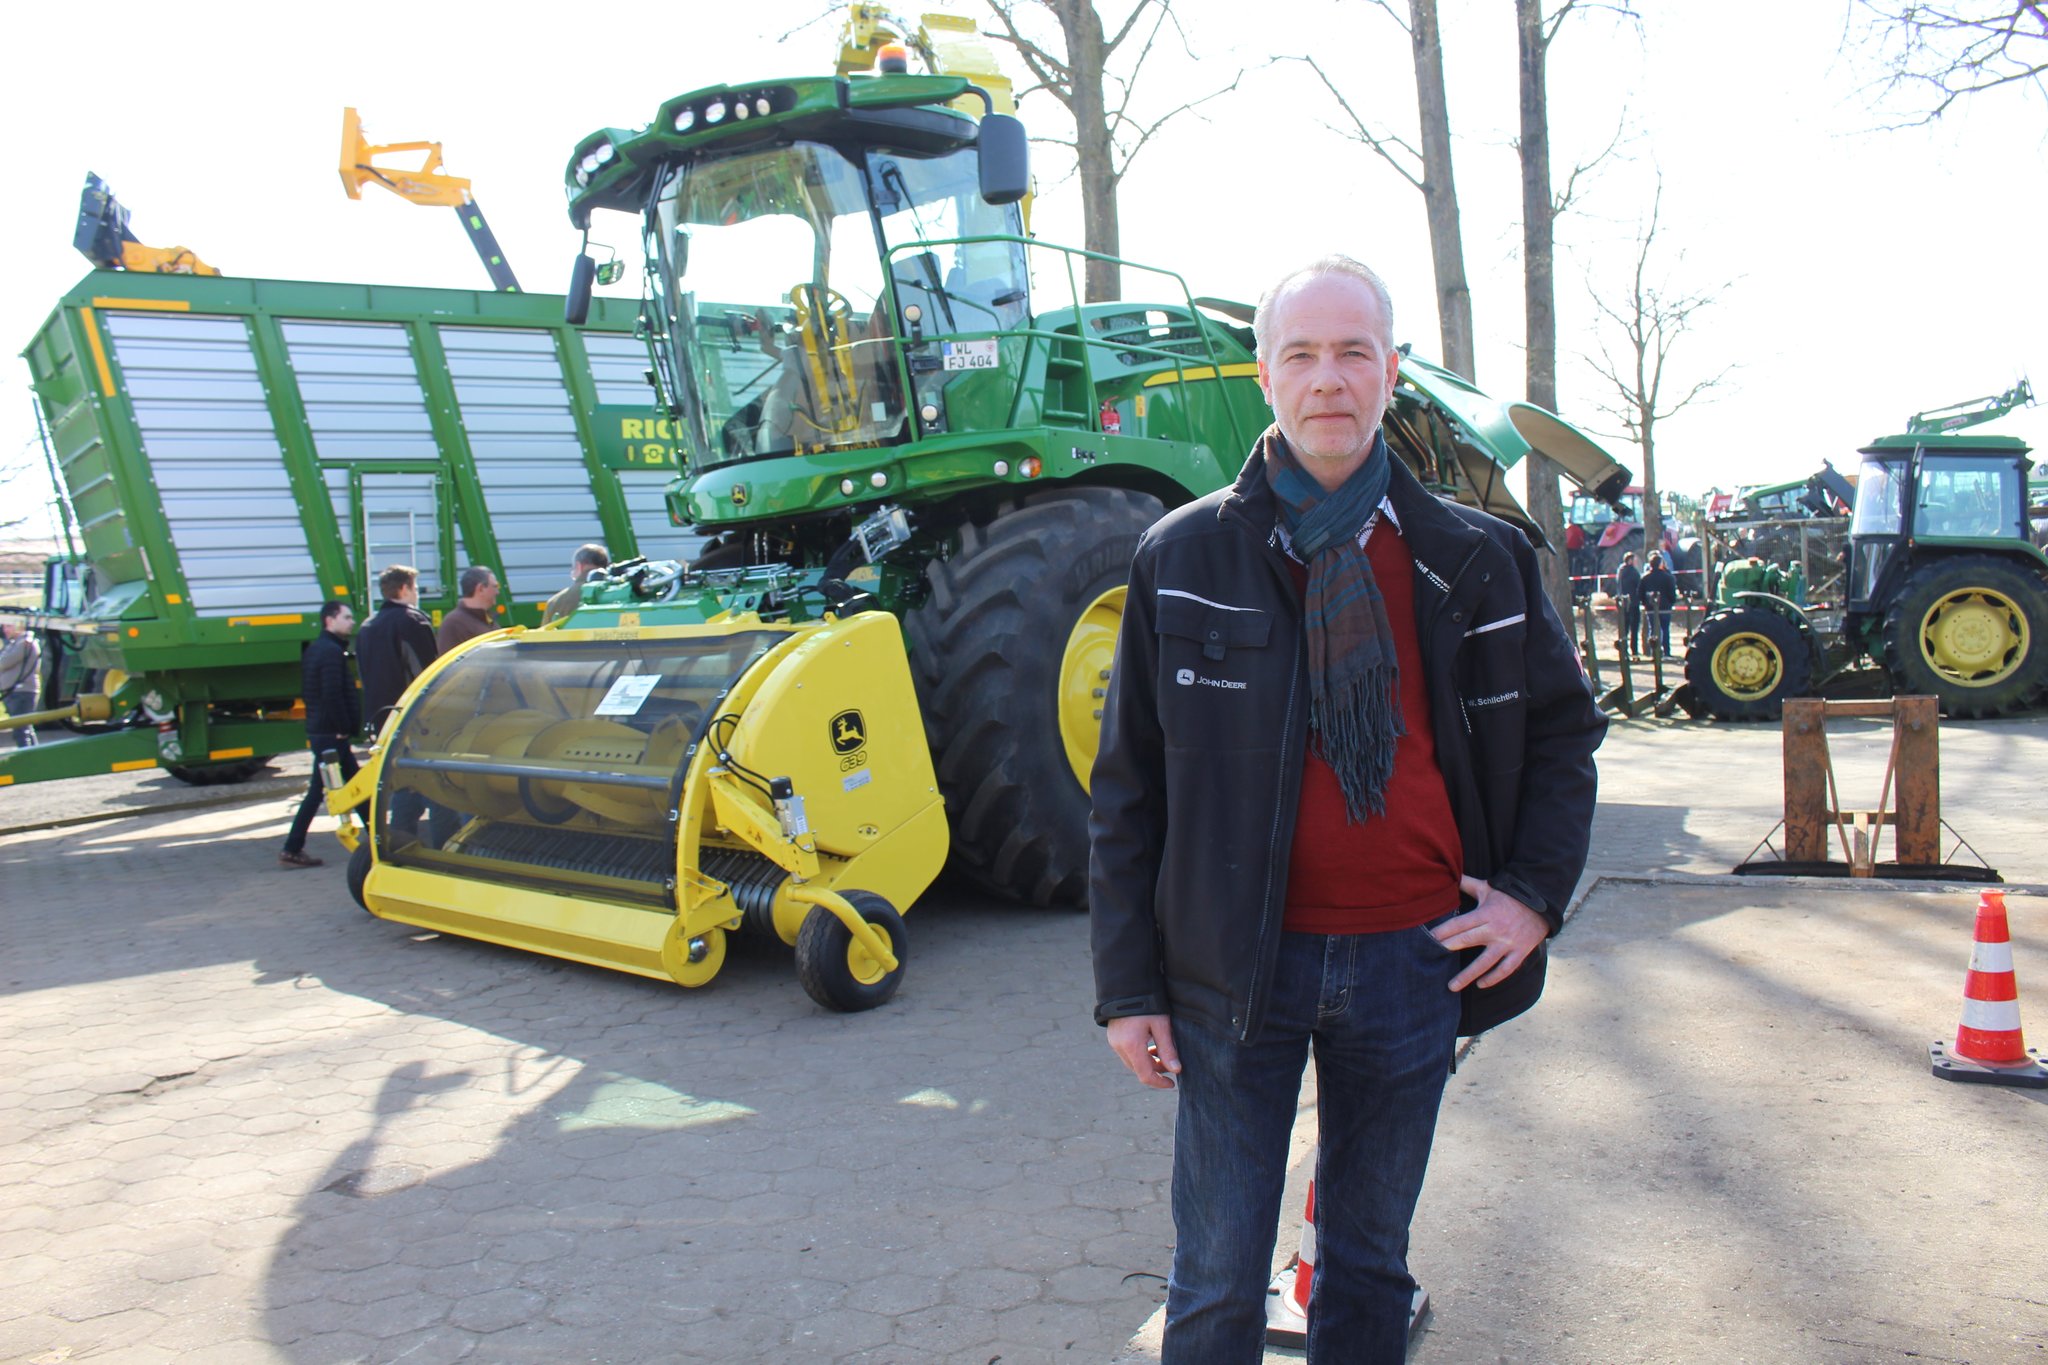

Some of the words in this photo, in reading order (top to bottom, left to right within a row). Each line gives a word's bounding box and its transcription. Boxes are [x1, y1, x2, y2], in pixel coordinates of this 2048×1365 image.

[955, 343, 972, 356] WL
[949, 357, 966, 369] FJ
[969, 355, 993, 368] 404
[1196, 676, 1221, 688] JOHN
[1221, 679, 1247, 690] DEERE
[1477, 690, 1519, 706] Schlichting
[840, 750, 867, 772] 639
